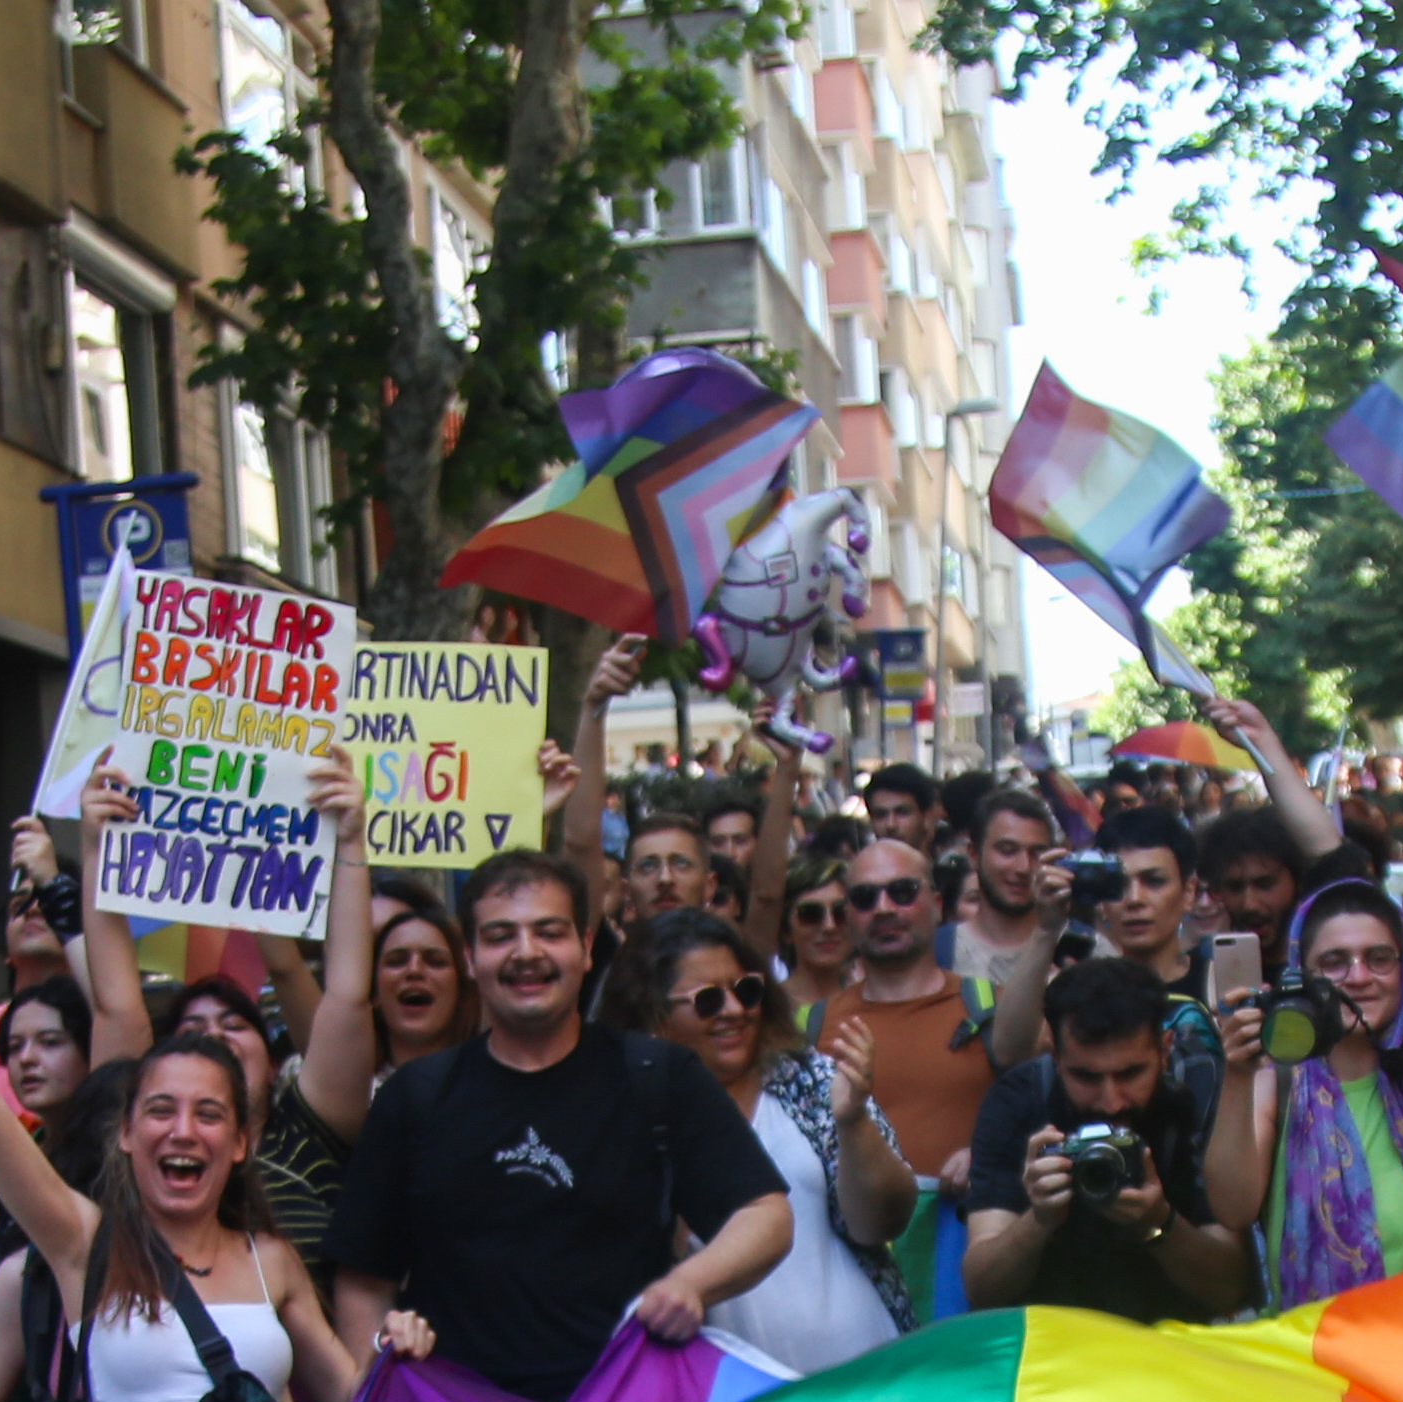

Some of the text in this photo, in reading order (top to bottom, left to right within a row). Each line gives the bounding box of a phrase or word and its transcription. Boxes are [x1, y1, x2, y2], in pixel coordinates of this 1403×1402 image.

[137, 576, 335, 660] YASAKLAR
[132, 631, 339, 713] BASKILAR
[368, 810, 465, 855] ÇIKAR
